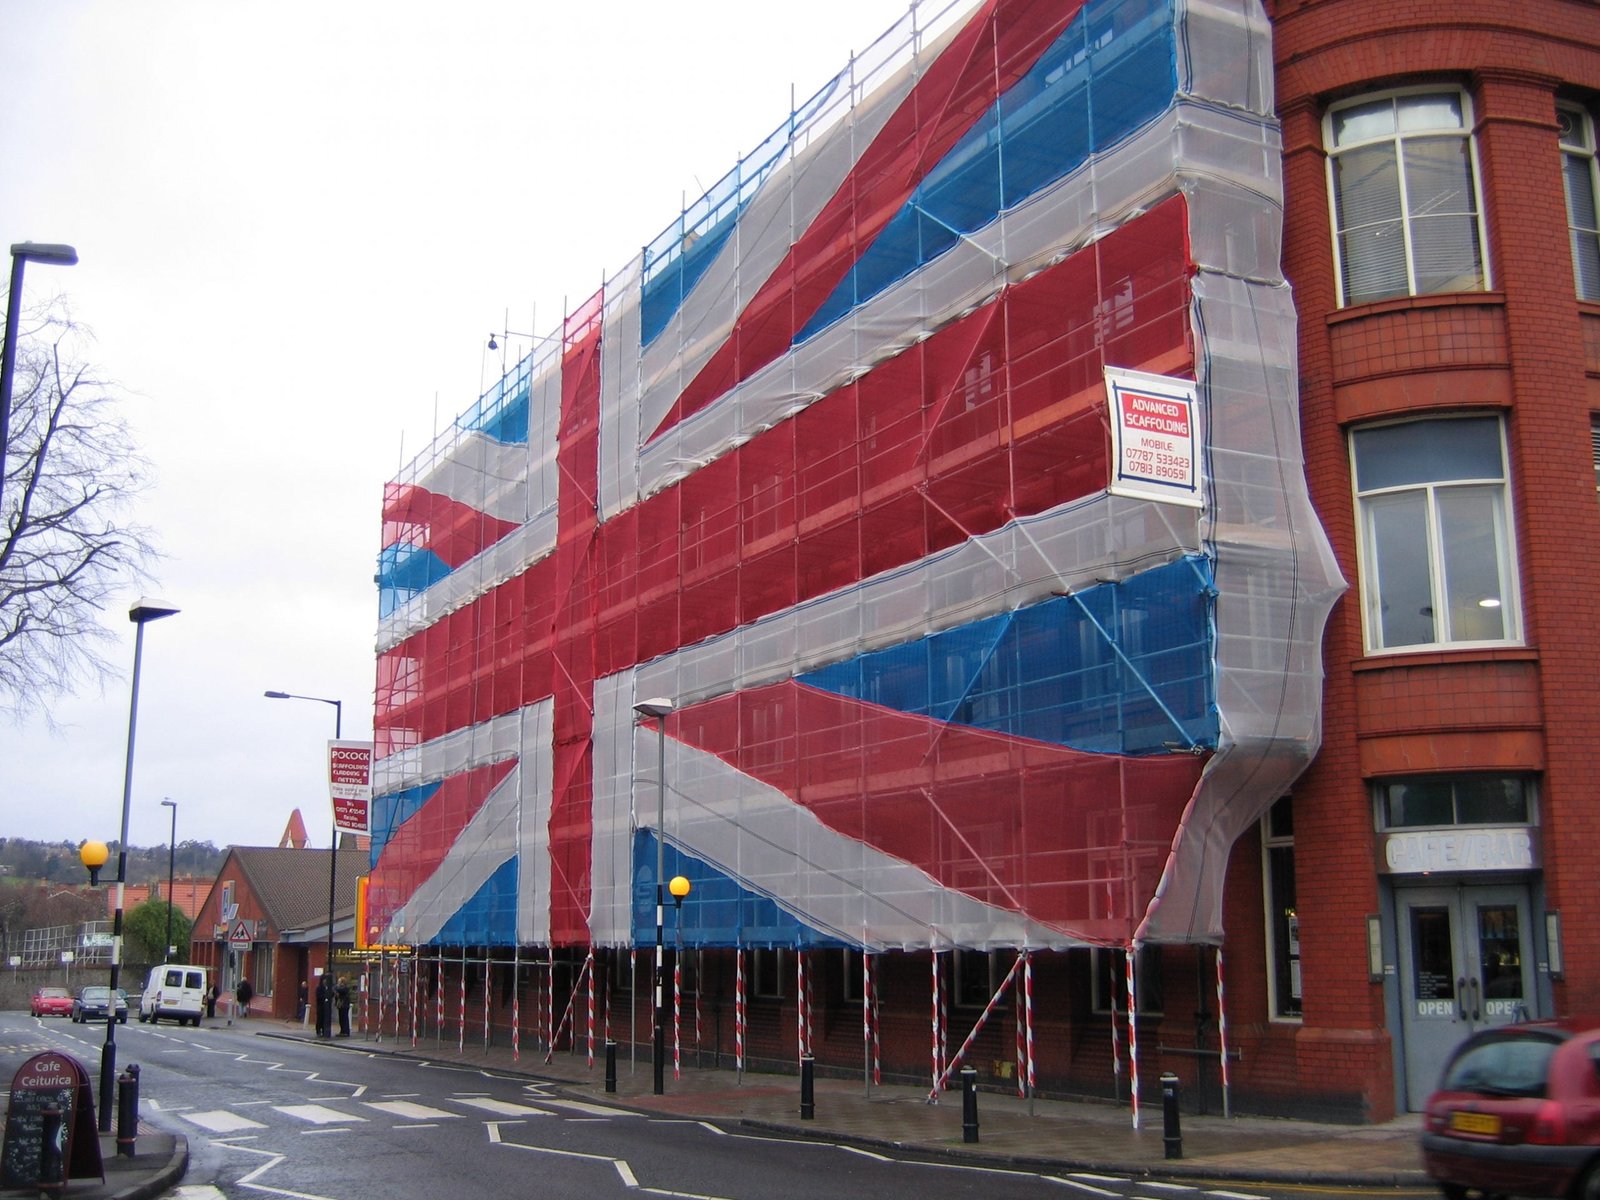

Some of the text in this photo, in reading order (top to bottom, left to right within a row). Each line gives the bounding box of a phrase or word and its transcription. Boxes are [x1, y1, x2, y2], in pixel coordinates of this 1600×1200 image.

[1132, 399, 1179, 416] ADVANCED
[1126, 414, 1188, 434] SCAFFOLDING
[1126, 448, 1189, 468] 07787 533423
[1129, 461, 1187, 480] 07813 890591
[332, 751, 369, 760] POCOCK
[1418, 1001, 1453, 1015] OPEN
[35, 1061, 61, 1072] Cafe
[22, 1075, 71, 1087] Ceiturica
